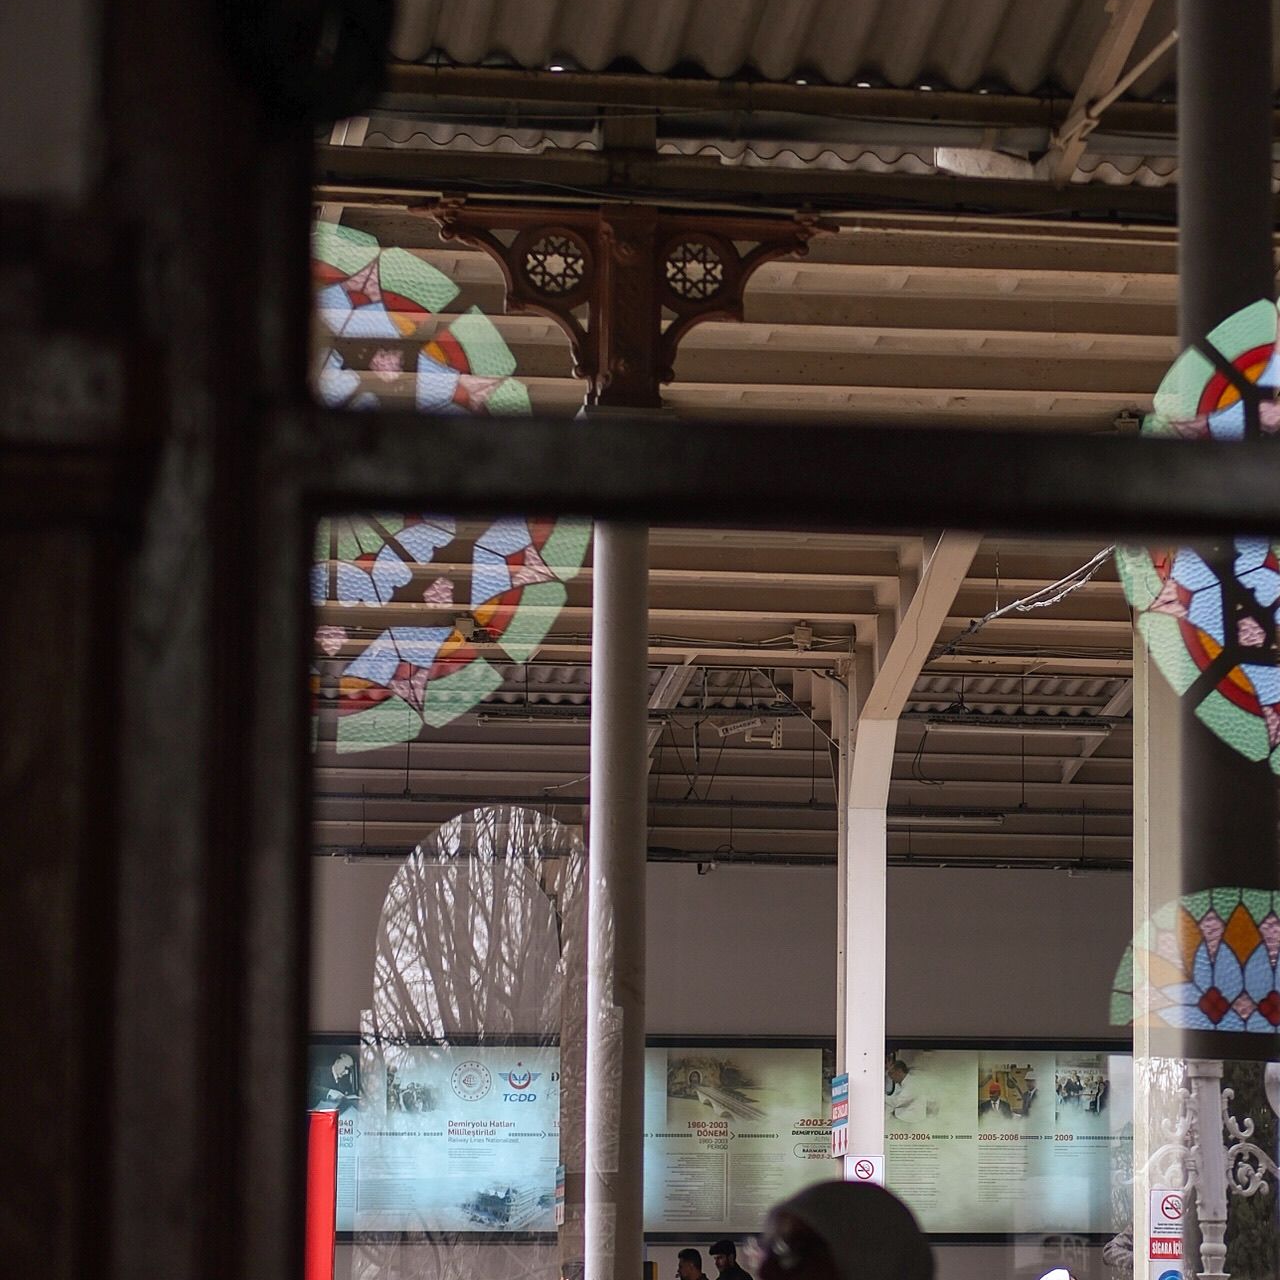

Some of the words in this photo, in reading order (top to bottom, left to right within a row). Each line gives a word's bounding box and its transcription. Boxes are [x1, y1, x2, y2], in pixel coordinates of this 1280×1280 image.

[503, 1093, 537, 1102] TCDD
[448, 1120, 488, 1129] Demiryolu
[687, 1121, 729, 1129] 1960-2003
[696, 1129, 729, 1138] DÖNEMİ
[889, 1133, 931, 1141] 2003-2004
[1054, 1134, 1074, 1142] 2009
[1152, 1240, 1173, 1255] SİGARA
